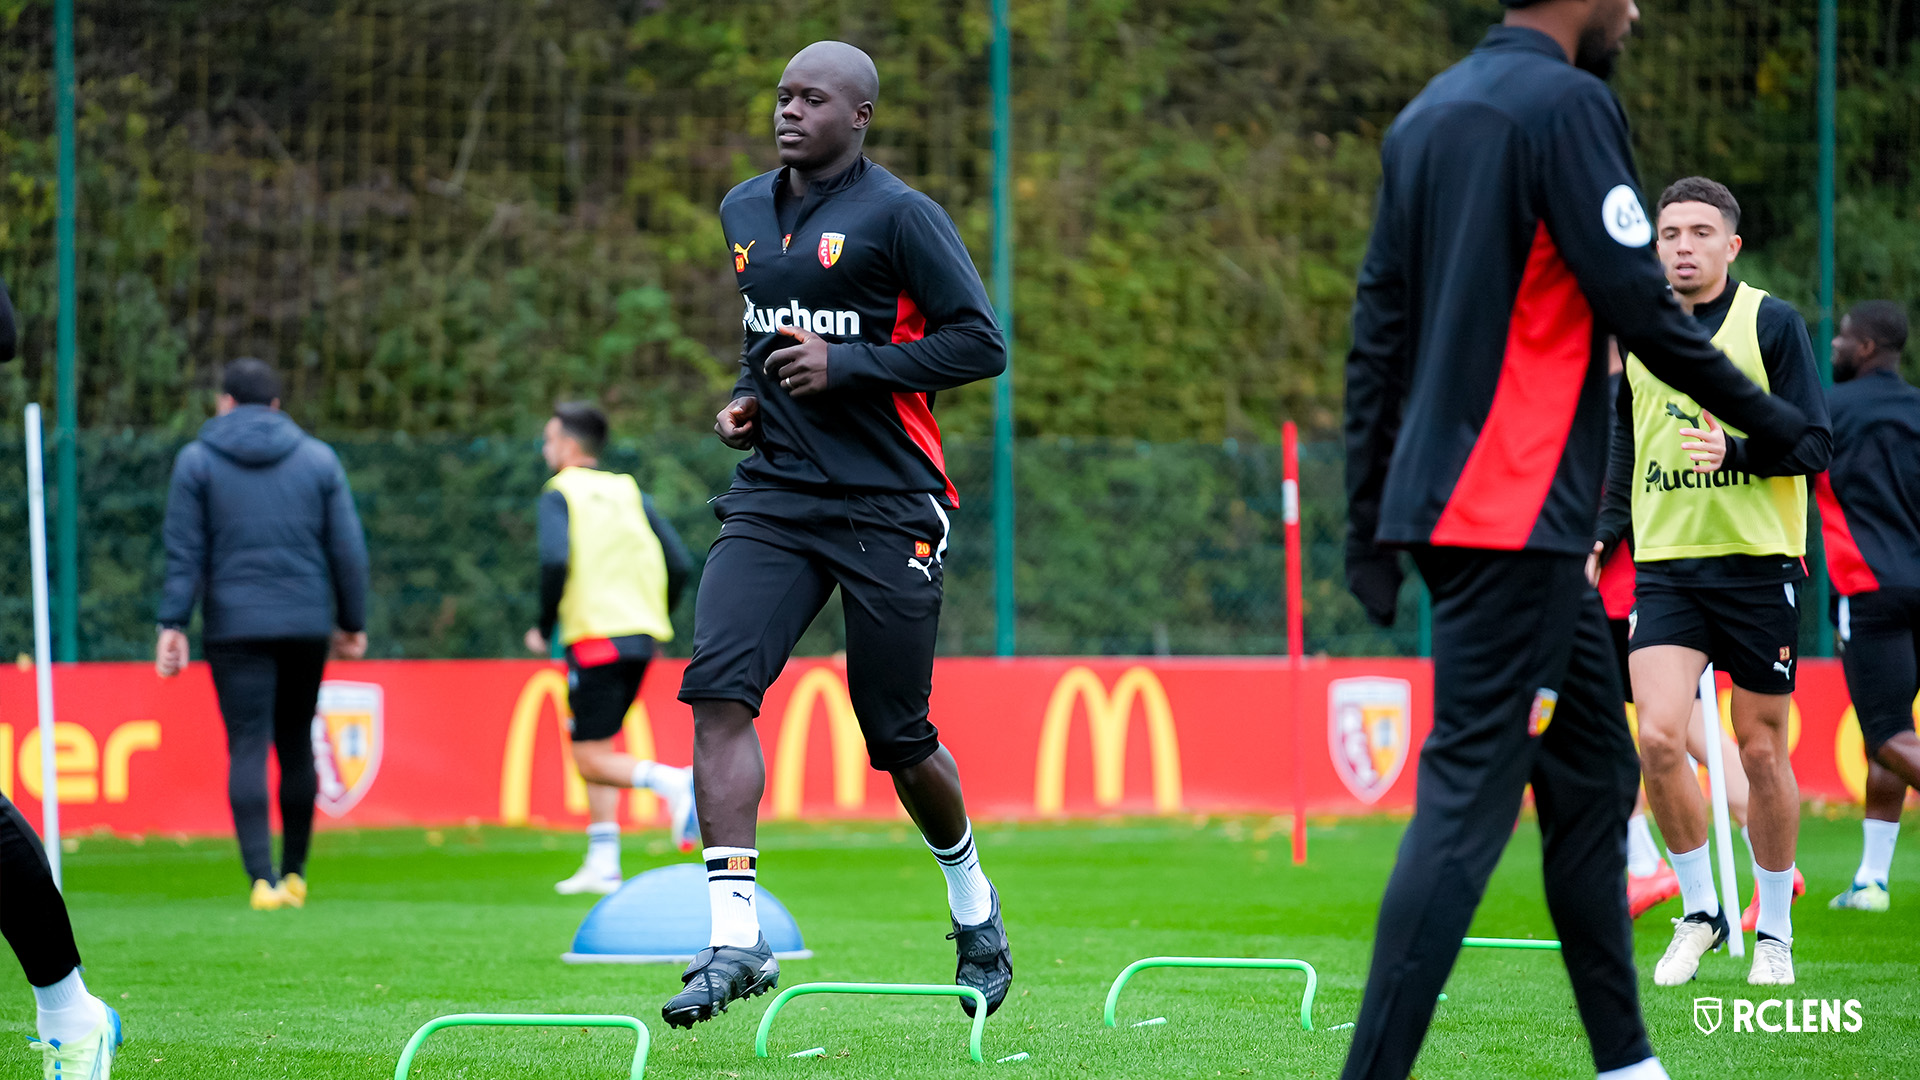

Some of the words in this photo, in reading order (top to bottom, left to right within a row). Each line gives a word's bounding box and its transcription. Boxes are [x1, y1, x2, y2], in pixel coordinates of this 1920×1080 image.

[742, 293, 860, 336] Auchan
[1645, 459, 1751, 493] Auchan
[916, 543, 930, 555] 20
[0, 719, 161, 804] er
[968, 945, 997, 957] adidas
